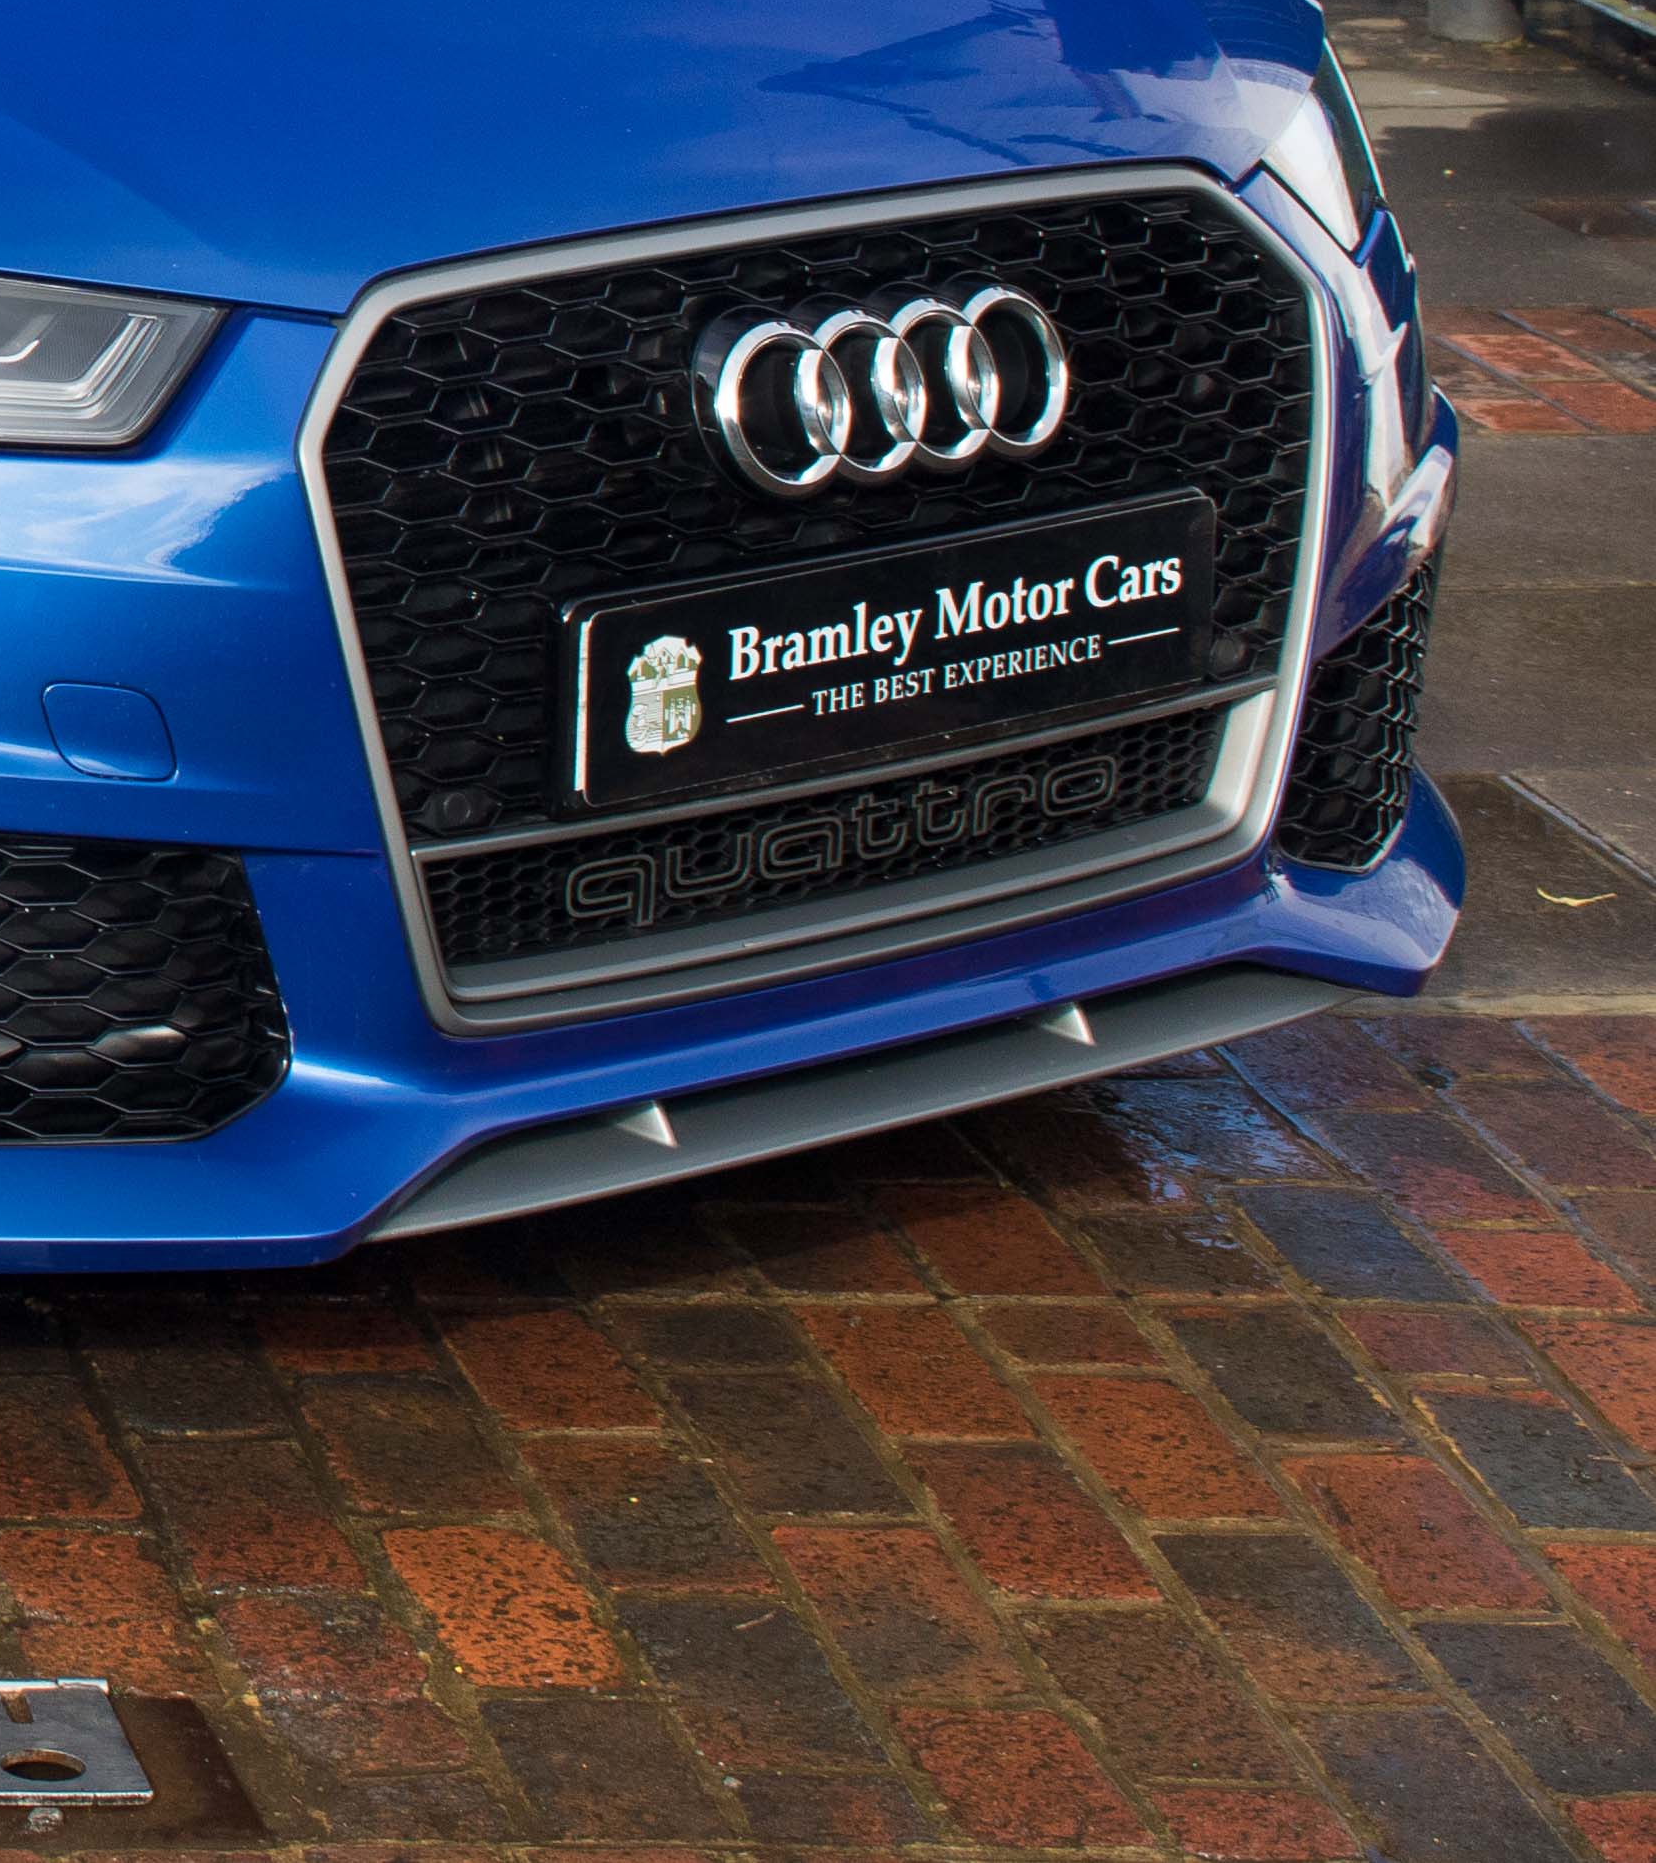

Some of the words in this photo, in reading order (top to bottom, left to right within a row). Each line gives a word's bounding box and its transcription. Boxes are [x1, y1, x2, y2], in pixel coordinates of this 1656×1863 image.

[727, 601, 924, 681] Bramley
[934, 573, 1075, 640] Motor
[1084, 553, 1184, 609] Cars
[811, 682, 867, 717] THE
[873, 668, 937, 705] BEST
[943, 634, 1103, 690] EXPERIENCE
[565, 754, 1120, 928] quattro
